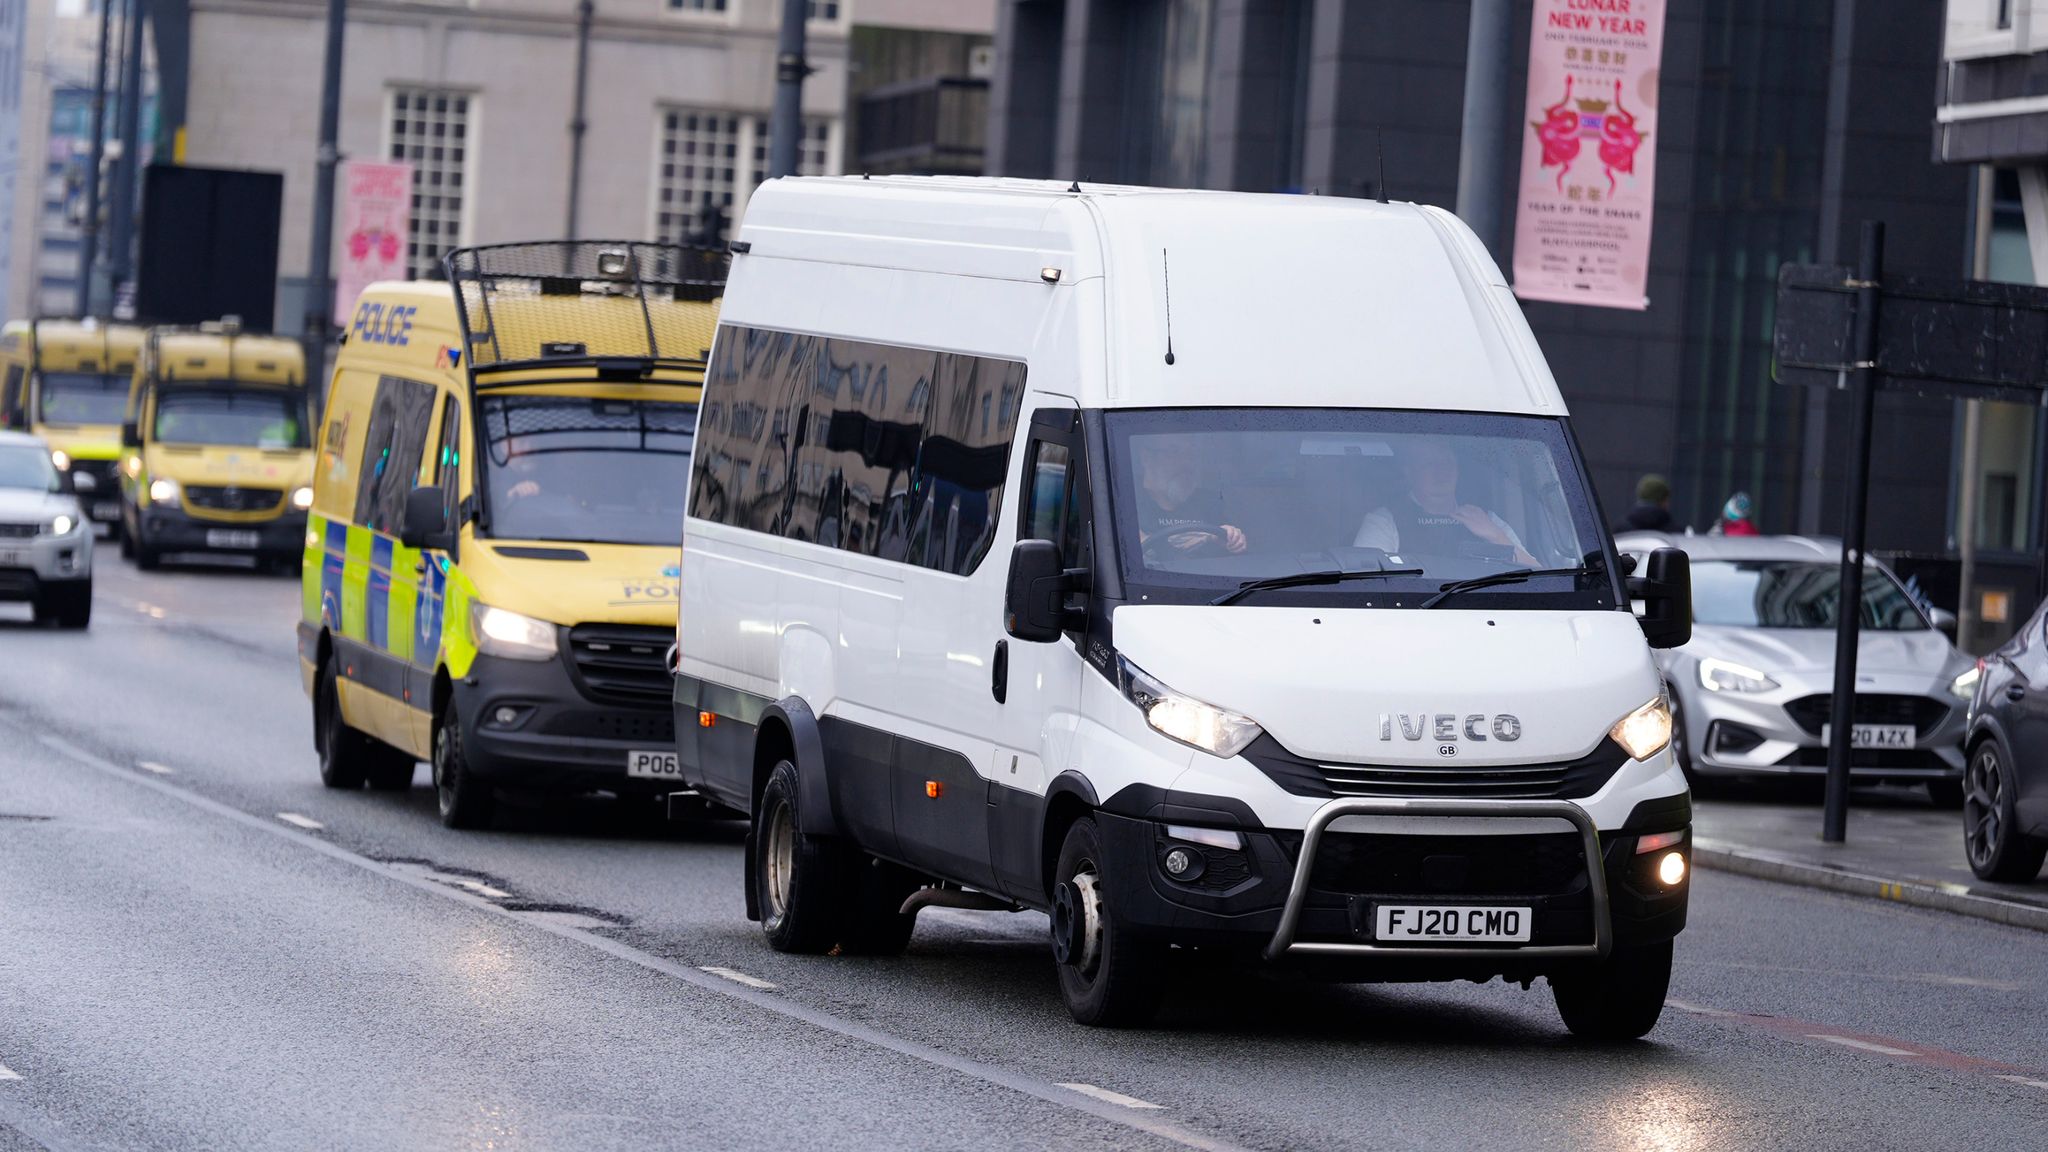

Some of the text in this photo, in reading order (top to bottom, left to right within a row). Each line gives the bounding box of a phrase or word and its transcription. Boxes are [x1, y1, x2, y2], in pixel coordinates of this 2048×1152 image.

[1567, 0, 1631, 14] LUNAR
[1548, 11, 1647, 35] NEW YEAR
[1528, 202, 1641, 219] YEAR OF THE SNAKE
[351, 302, 417, 346] POLICE
[1379, 714, 1522, 742] IVECO
[1439, 746, 1455, 755] GB
[1388, 909, 1520, 936] FJ20 CMO
